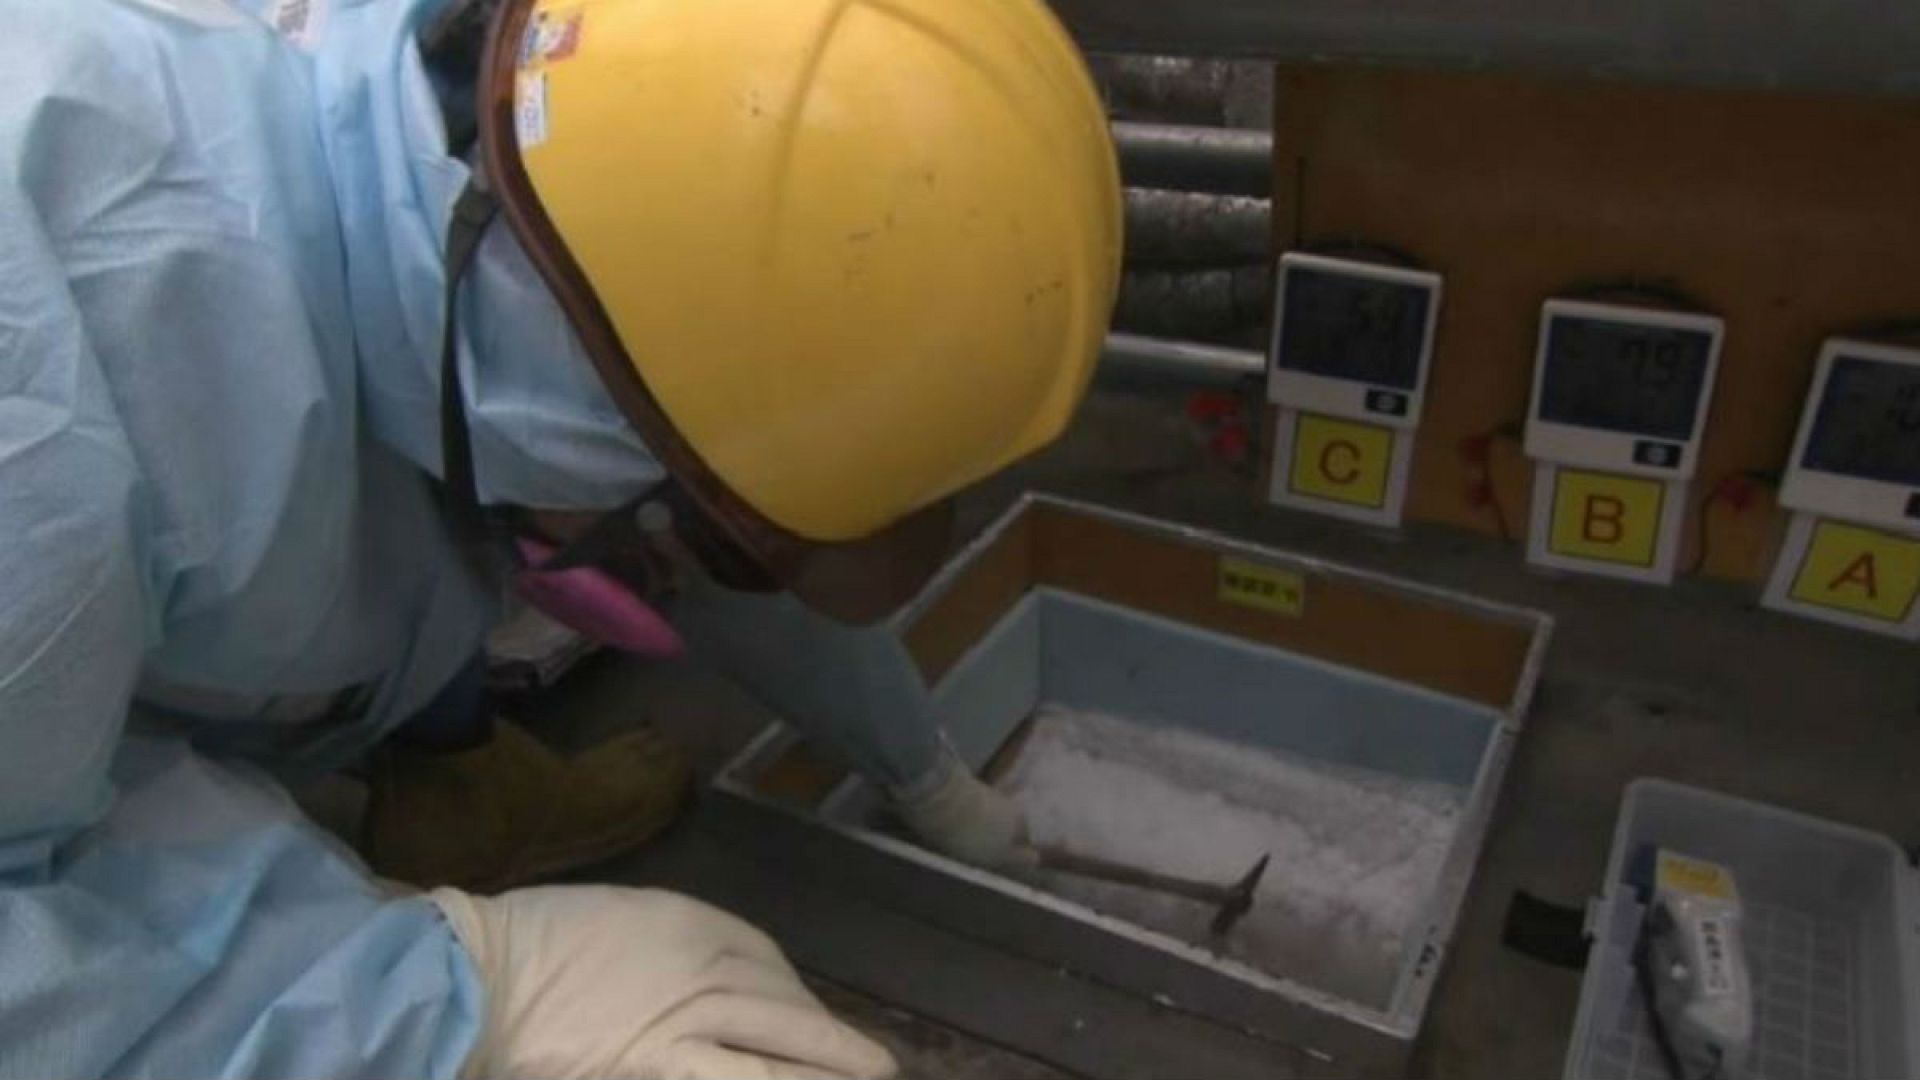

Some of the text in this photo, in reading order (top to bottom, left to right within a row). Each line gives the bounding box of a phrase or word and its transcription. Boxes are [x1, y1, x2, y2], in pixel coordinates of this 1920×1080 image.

[1319, 439, 1360, 485] C
[1583, 494, 1625, 544] B
[1827, 551, 1877, 599] A
